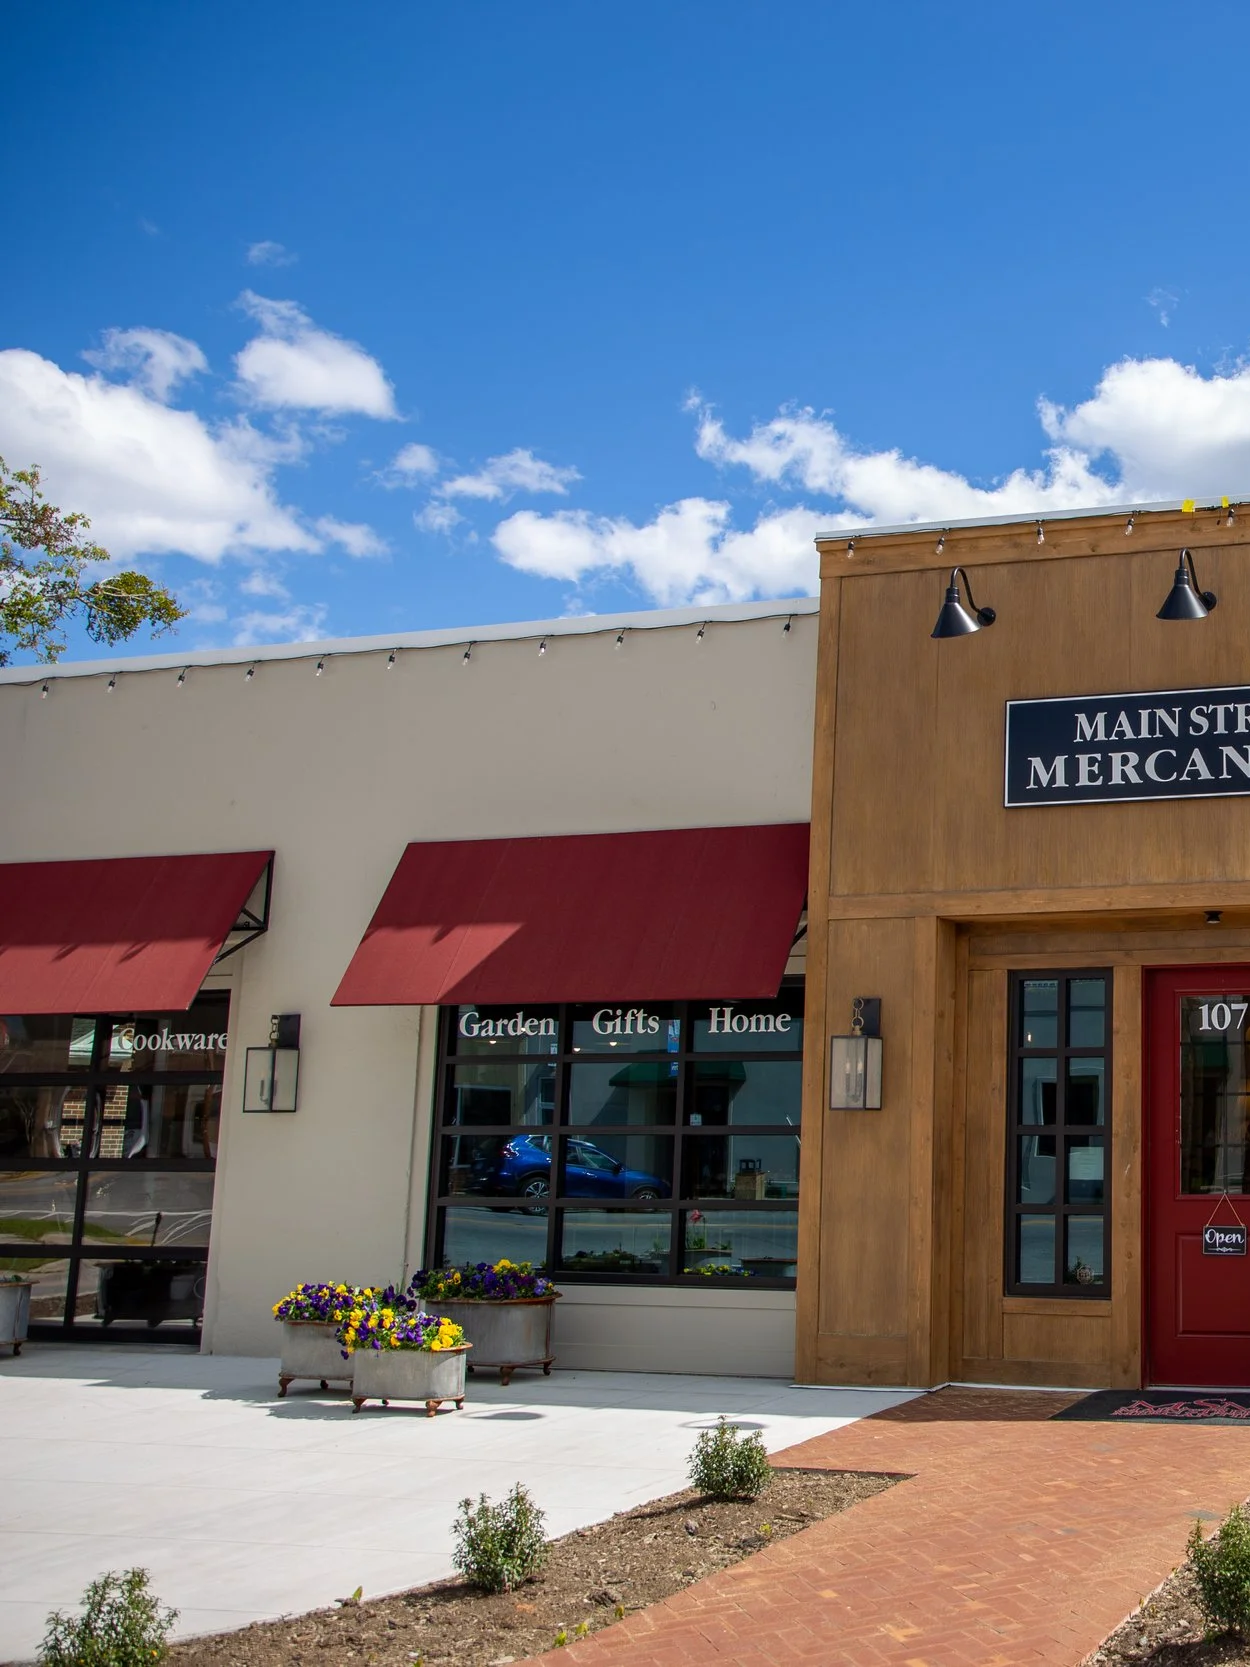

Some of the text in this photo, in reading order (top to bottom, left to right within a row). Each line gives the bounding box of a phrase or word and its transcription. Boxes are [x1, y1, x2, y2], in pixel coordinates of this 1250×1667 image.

[1073, 708, 1183, 743] MAIN
[459, 1007, 791, 1037] Garden Gifts Home
[1198, 1003, 1249, 1031] 107
[118, 1027, 228, 1051] Cookware
[1205, 1228, 1245, 1248] Open
